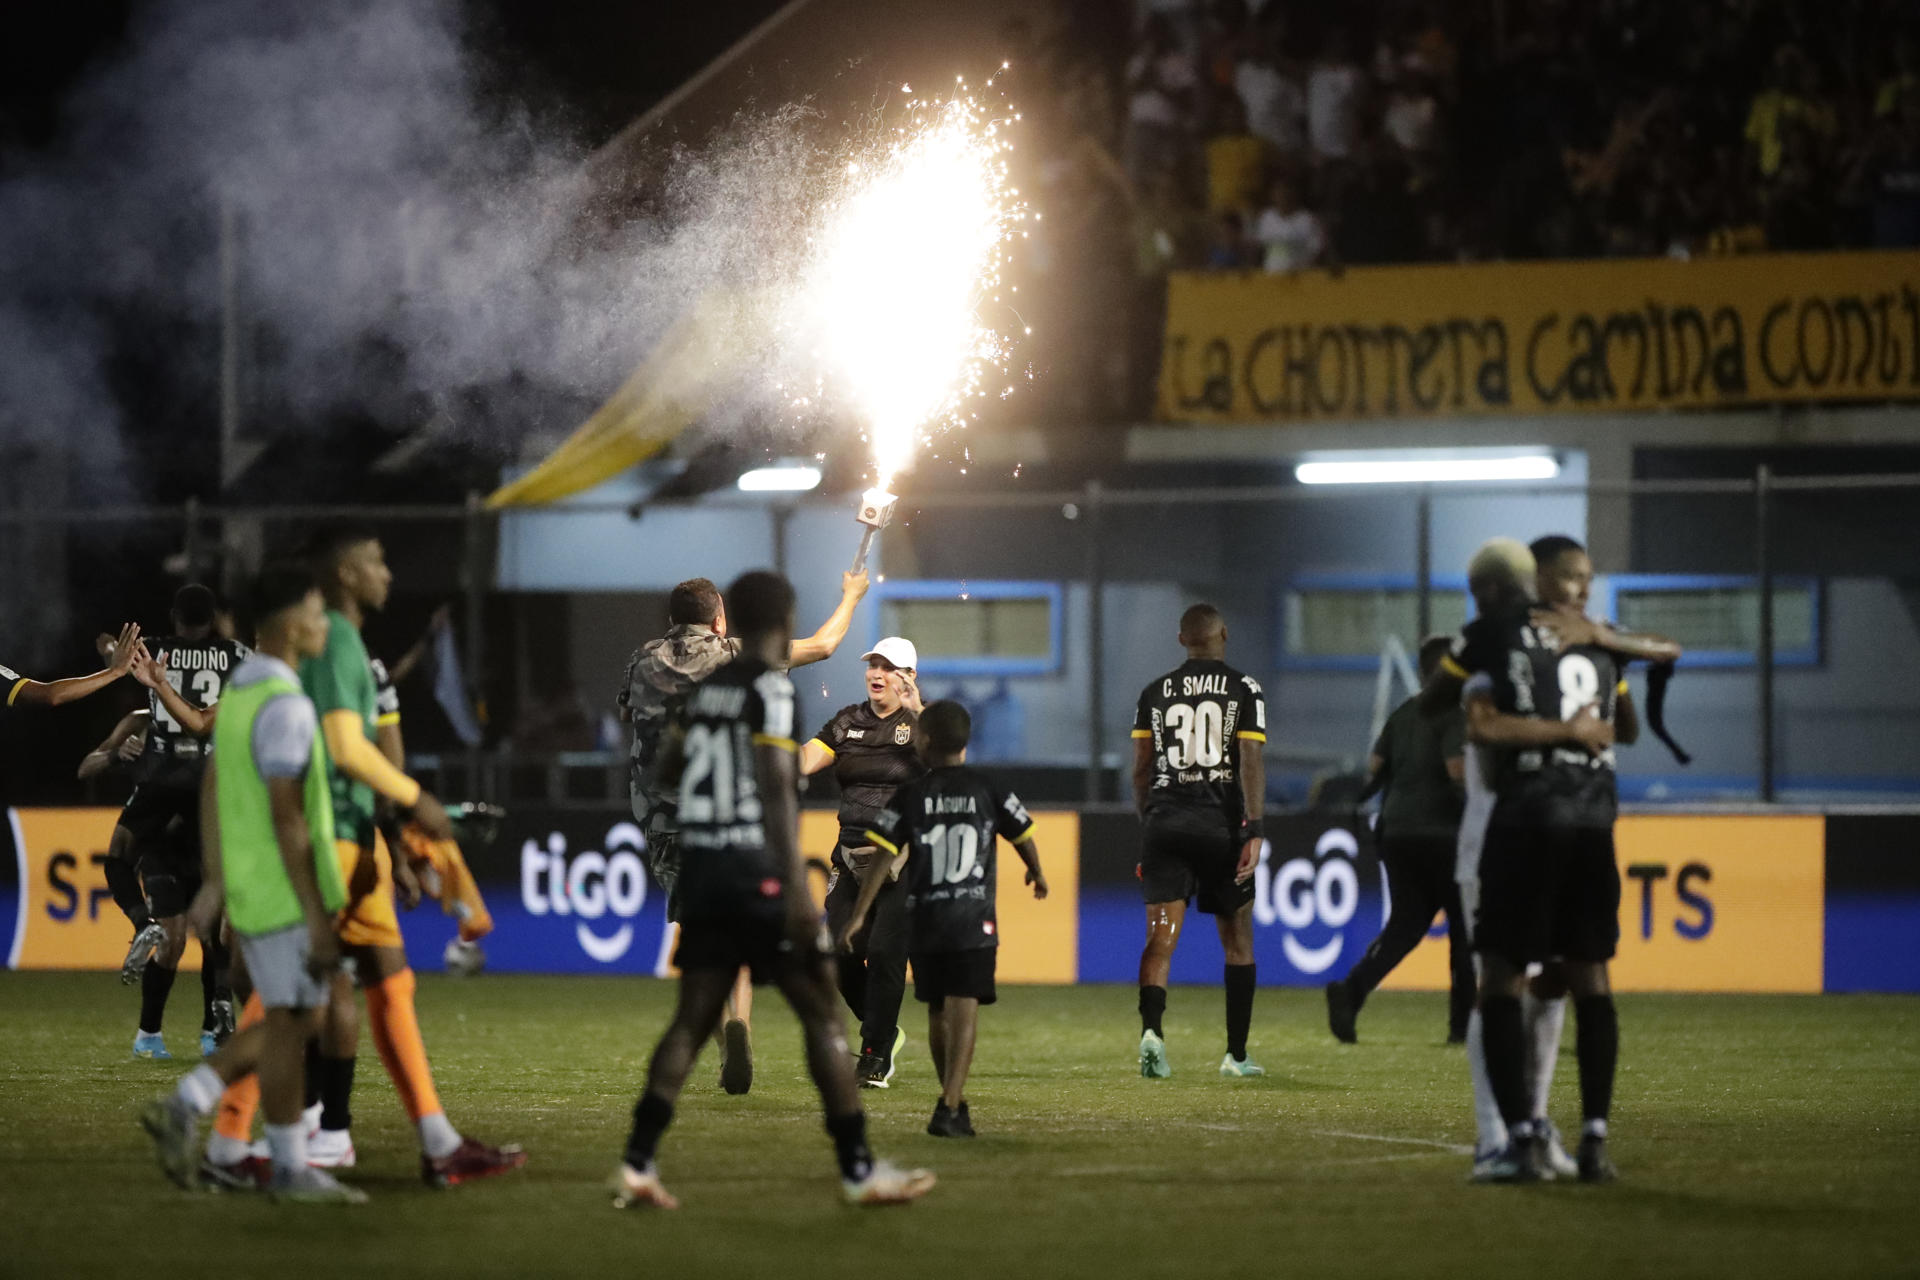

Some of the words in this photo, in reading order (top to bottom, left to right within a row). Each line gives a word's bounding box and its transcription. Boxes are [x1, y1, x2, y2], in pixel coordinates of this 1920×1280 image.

[171, 646, 228, 671] GUDIÑO
[1163, 678, 1177, 698] C.
[1558, 653, 1600, 724] 8
[1165, 700, 1223, 769] 30
[677, 721, 735, 823] 21
[921, 823, 978, 885] 10
